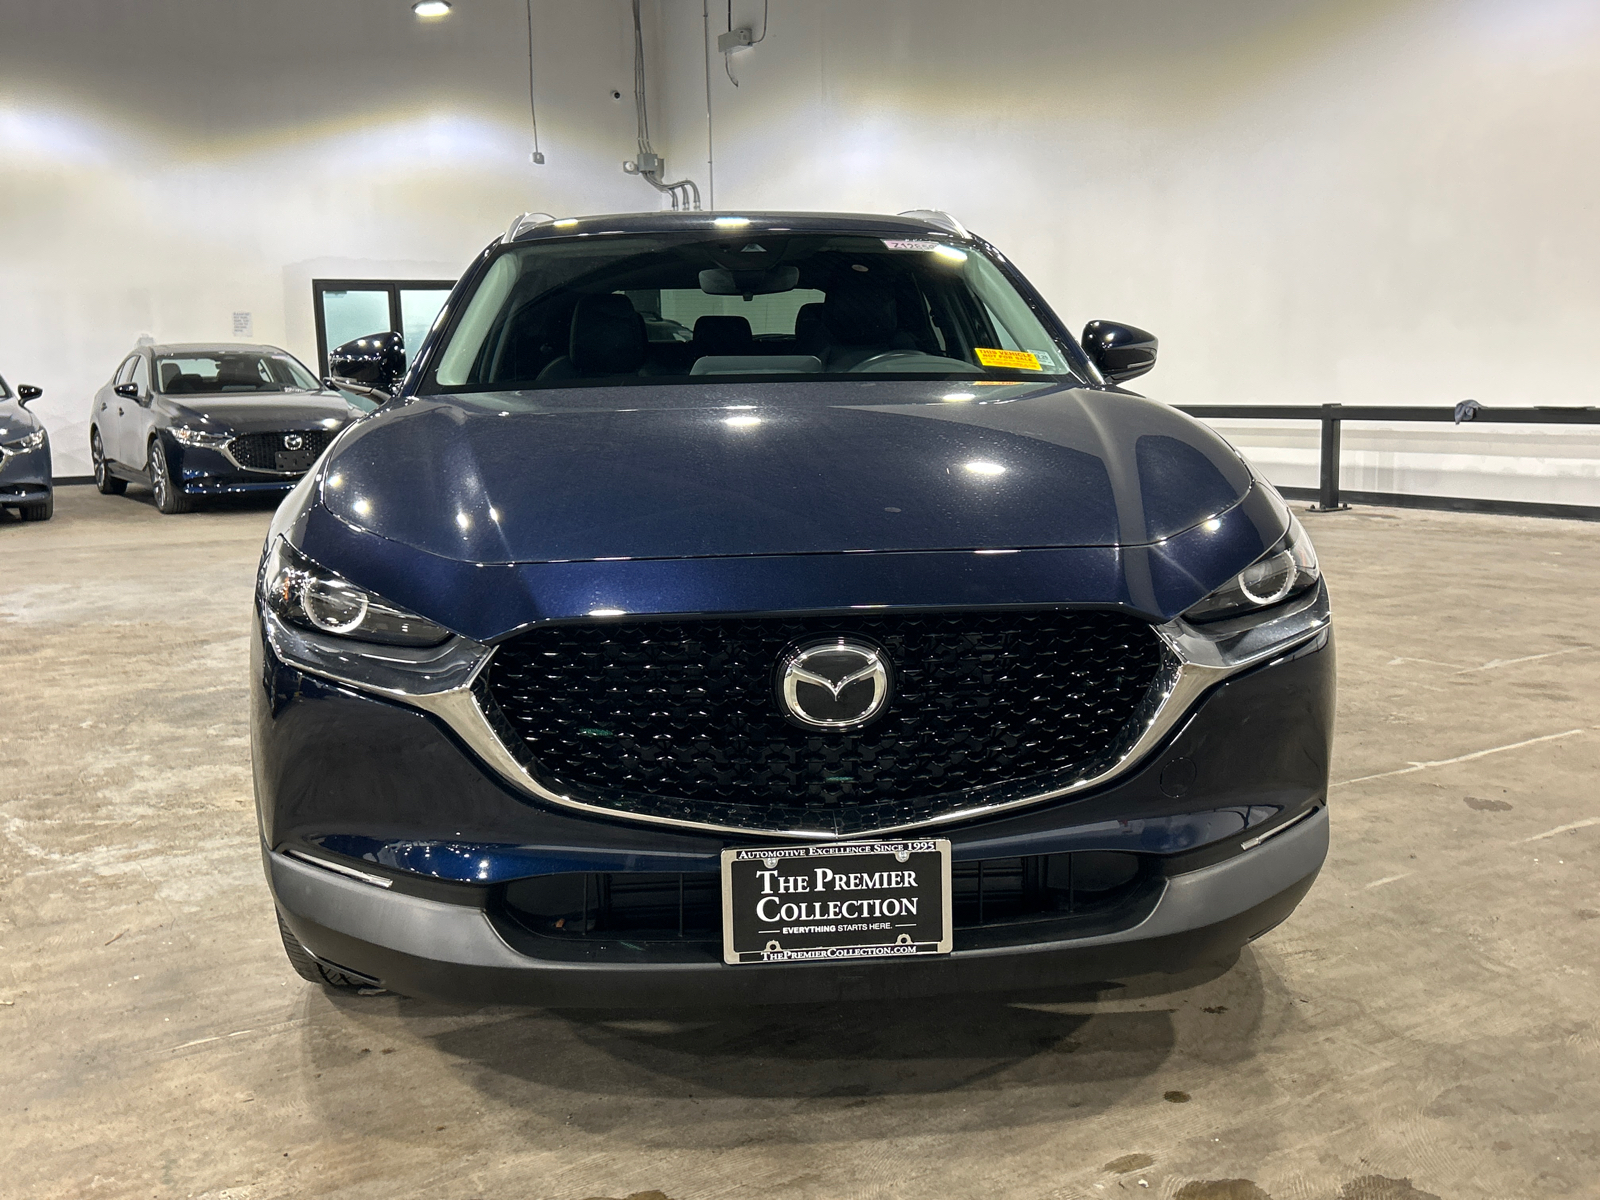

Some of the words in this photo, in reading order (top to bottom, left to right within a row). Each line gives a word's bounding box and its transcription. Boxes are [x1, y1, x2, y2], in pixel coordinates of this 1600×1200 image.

[739, 848, 805, 859] AUTOMOTIVE
[809, 846, 871, 855] EXCELLENCE
[874, 844, 904, 852] SINCE
[907, 842, 935, 851] 1995
[756, 870, 809, 895] THE
[814, 868, 918, 892] PREMIER
[756, 896, 918, 922] COLLECTION
[782, 925, 836, 934] EVERYTHING
[838, 924, 867, 932] STARTS
[869, 922, 893, 931] HERE.
[761, 946, 917, 961] THEPREMIERCOLLECTION.COM
